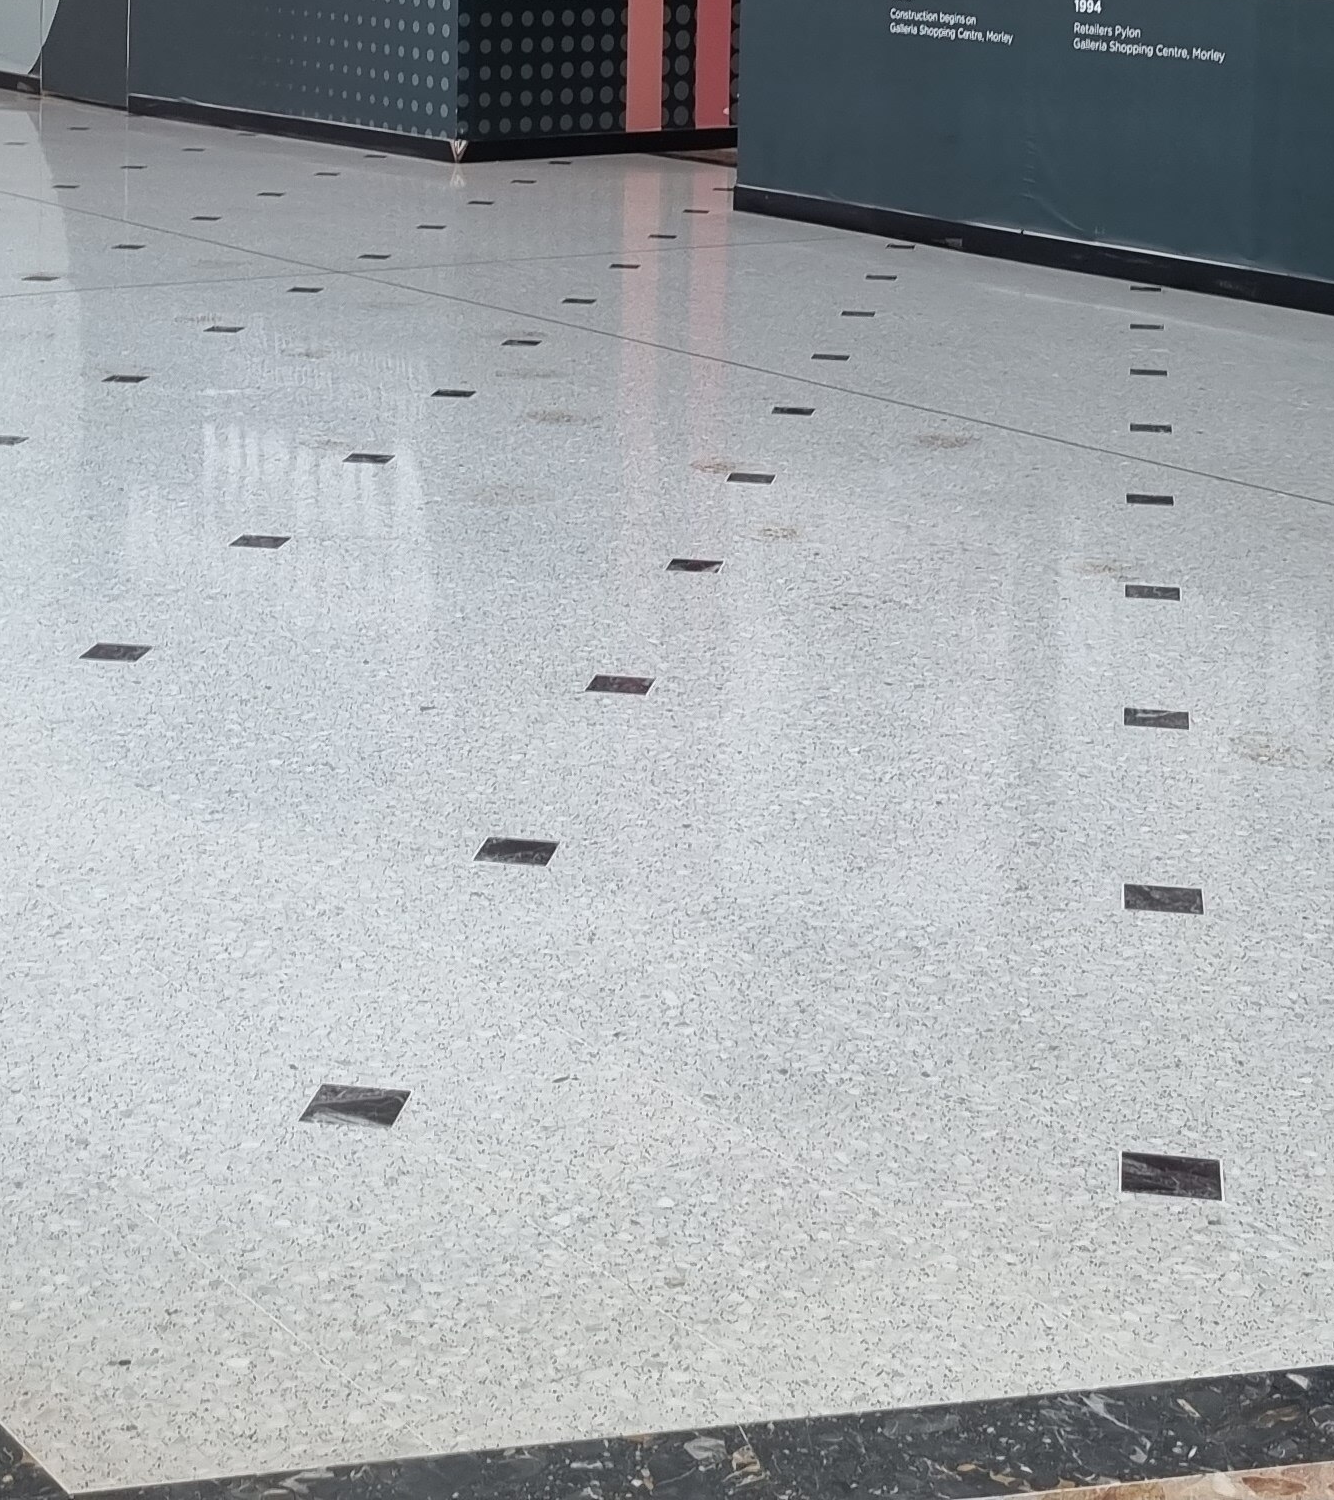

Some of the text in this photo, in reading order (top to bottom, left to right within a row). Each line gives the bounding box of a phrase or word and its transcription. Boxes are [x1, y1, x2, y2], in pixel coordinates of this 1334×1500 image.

[1074, 0, 1102, 13] 1994
[890, 8, 977, 25] Construction begins on
[889, 22, 1014, 45] Galleria Shopping Centre, Morley
[1073, 22, 1141, 39] Retailers Pylon
[1073, 38, 1226, 64] Galleria Shopping Centre, Morley
